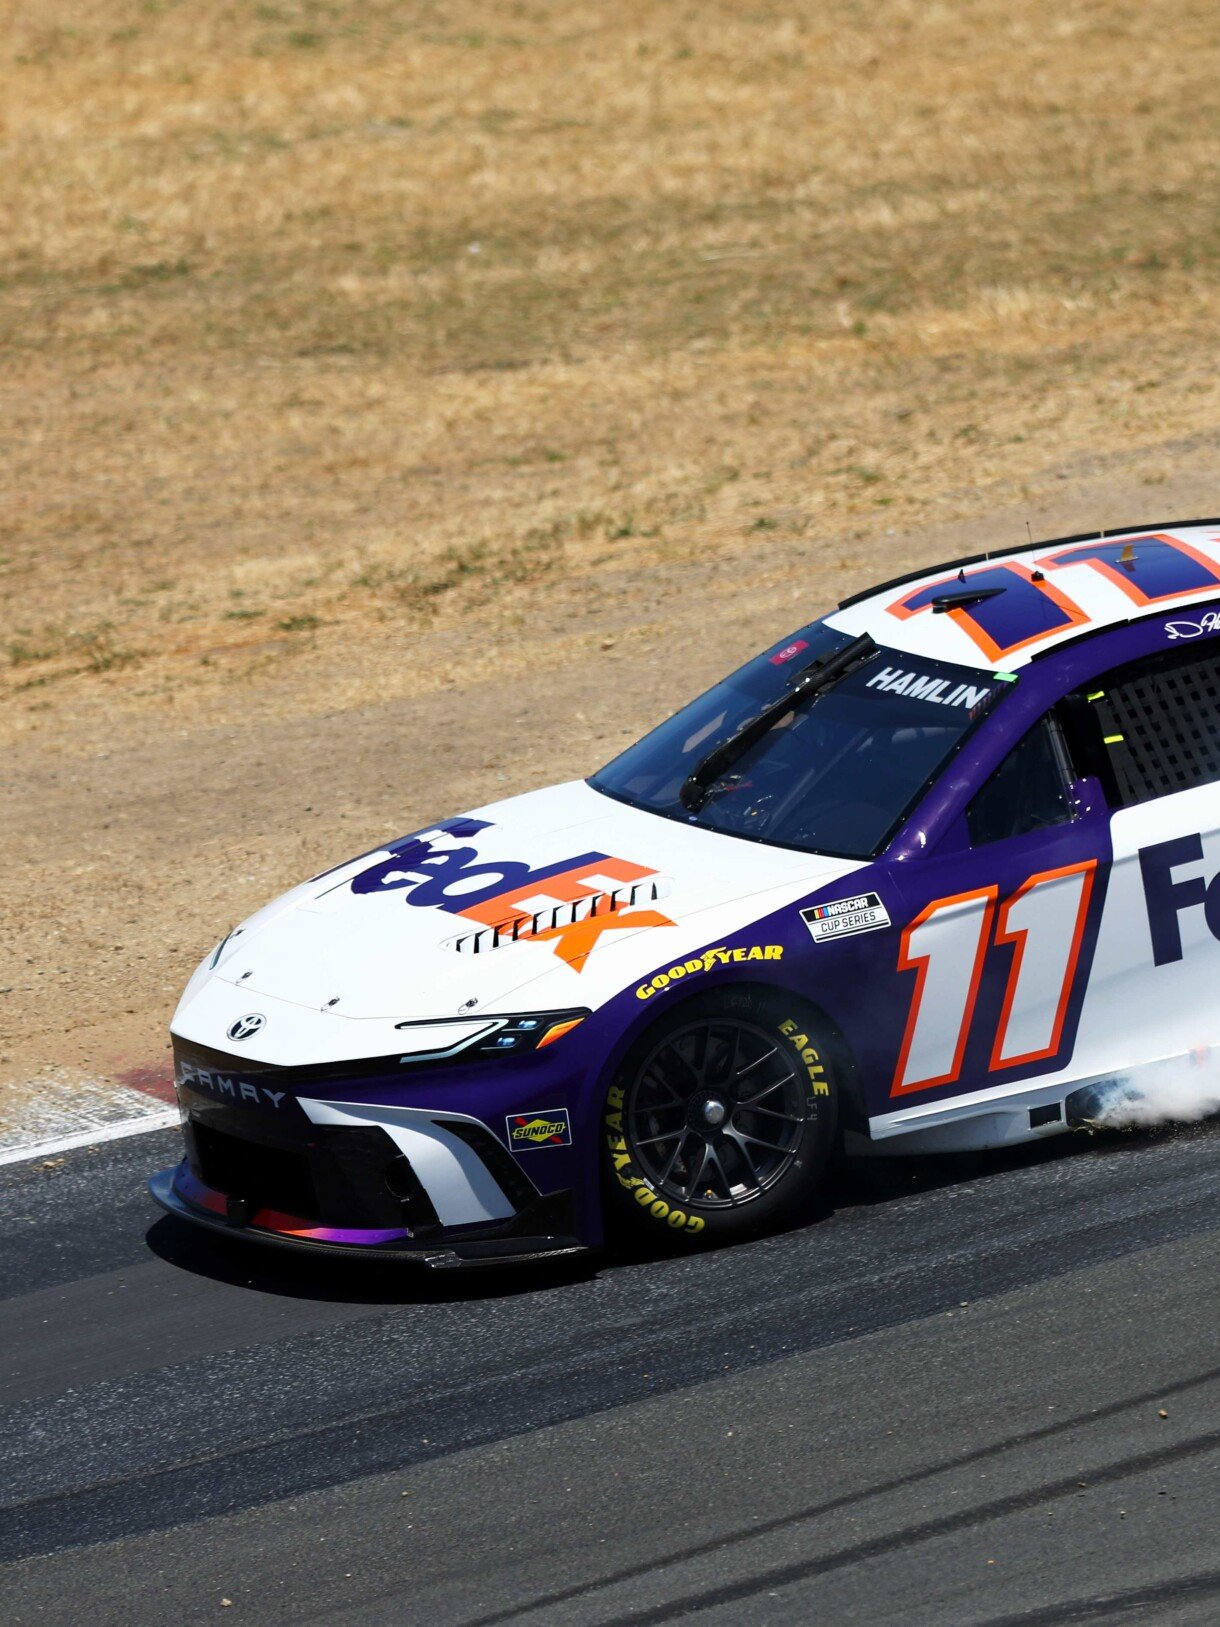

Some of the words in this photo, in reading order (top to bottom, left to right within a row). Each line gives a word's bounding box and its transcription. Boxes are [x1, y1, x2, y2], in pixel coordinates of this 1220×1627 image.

[865, 666, 990, 710] HAMLIN
[821, 919, 840, 932] CUP
[842, 911, 876, 928] SERIES
[827, 897, 869, 916] NASCAR
[636, 944, 784, 1000] GOODYEAR
[889, 859, 1098, 1098] 11
[777, 1018, 829, 1097] EAGLE
[515, 1123, 564, 1137] SUNOCO
[605, 1085, 705, 1234] GOODYEAR
